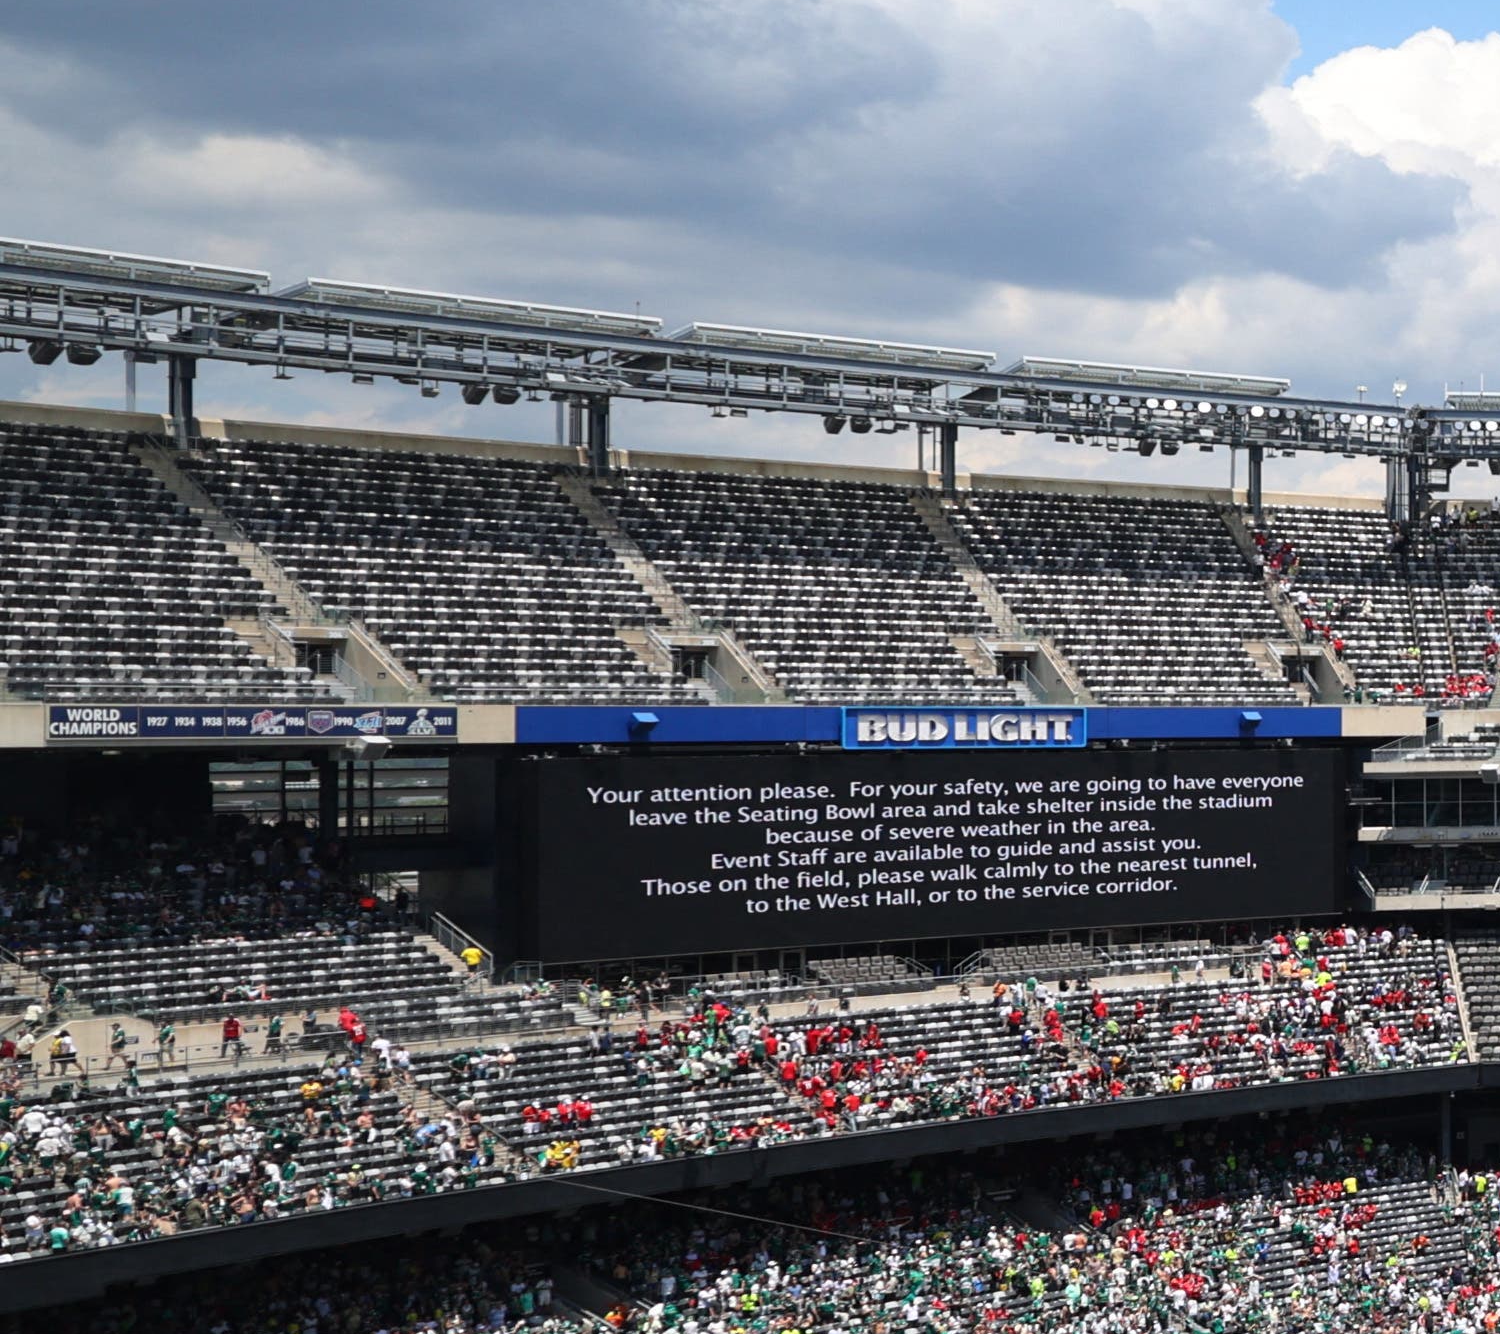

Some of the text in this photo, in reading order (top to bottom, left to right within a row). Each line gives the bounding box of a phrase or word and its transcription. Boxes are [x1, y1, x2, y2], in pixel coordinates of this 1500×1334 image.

[66, 708, 121, 722] WORLD
[147, 715, 452, 727] 1927 1934 1938 1956 1986 1990 2007 2011
[49, 721, 138, 735] CHAMPIONS
[857, 713, 1073, 742] BUD LIGHT
[586, 774, 1304, 804] Your attention please. For your safety, we are going to have everyone
[629, 793, 1273, 826] leave the Seating Bowl area and take shelter inside the stadium
